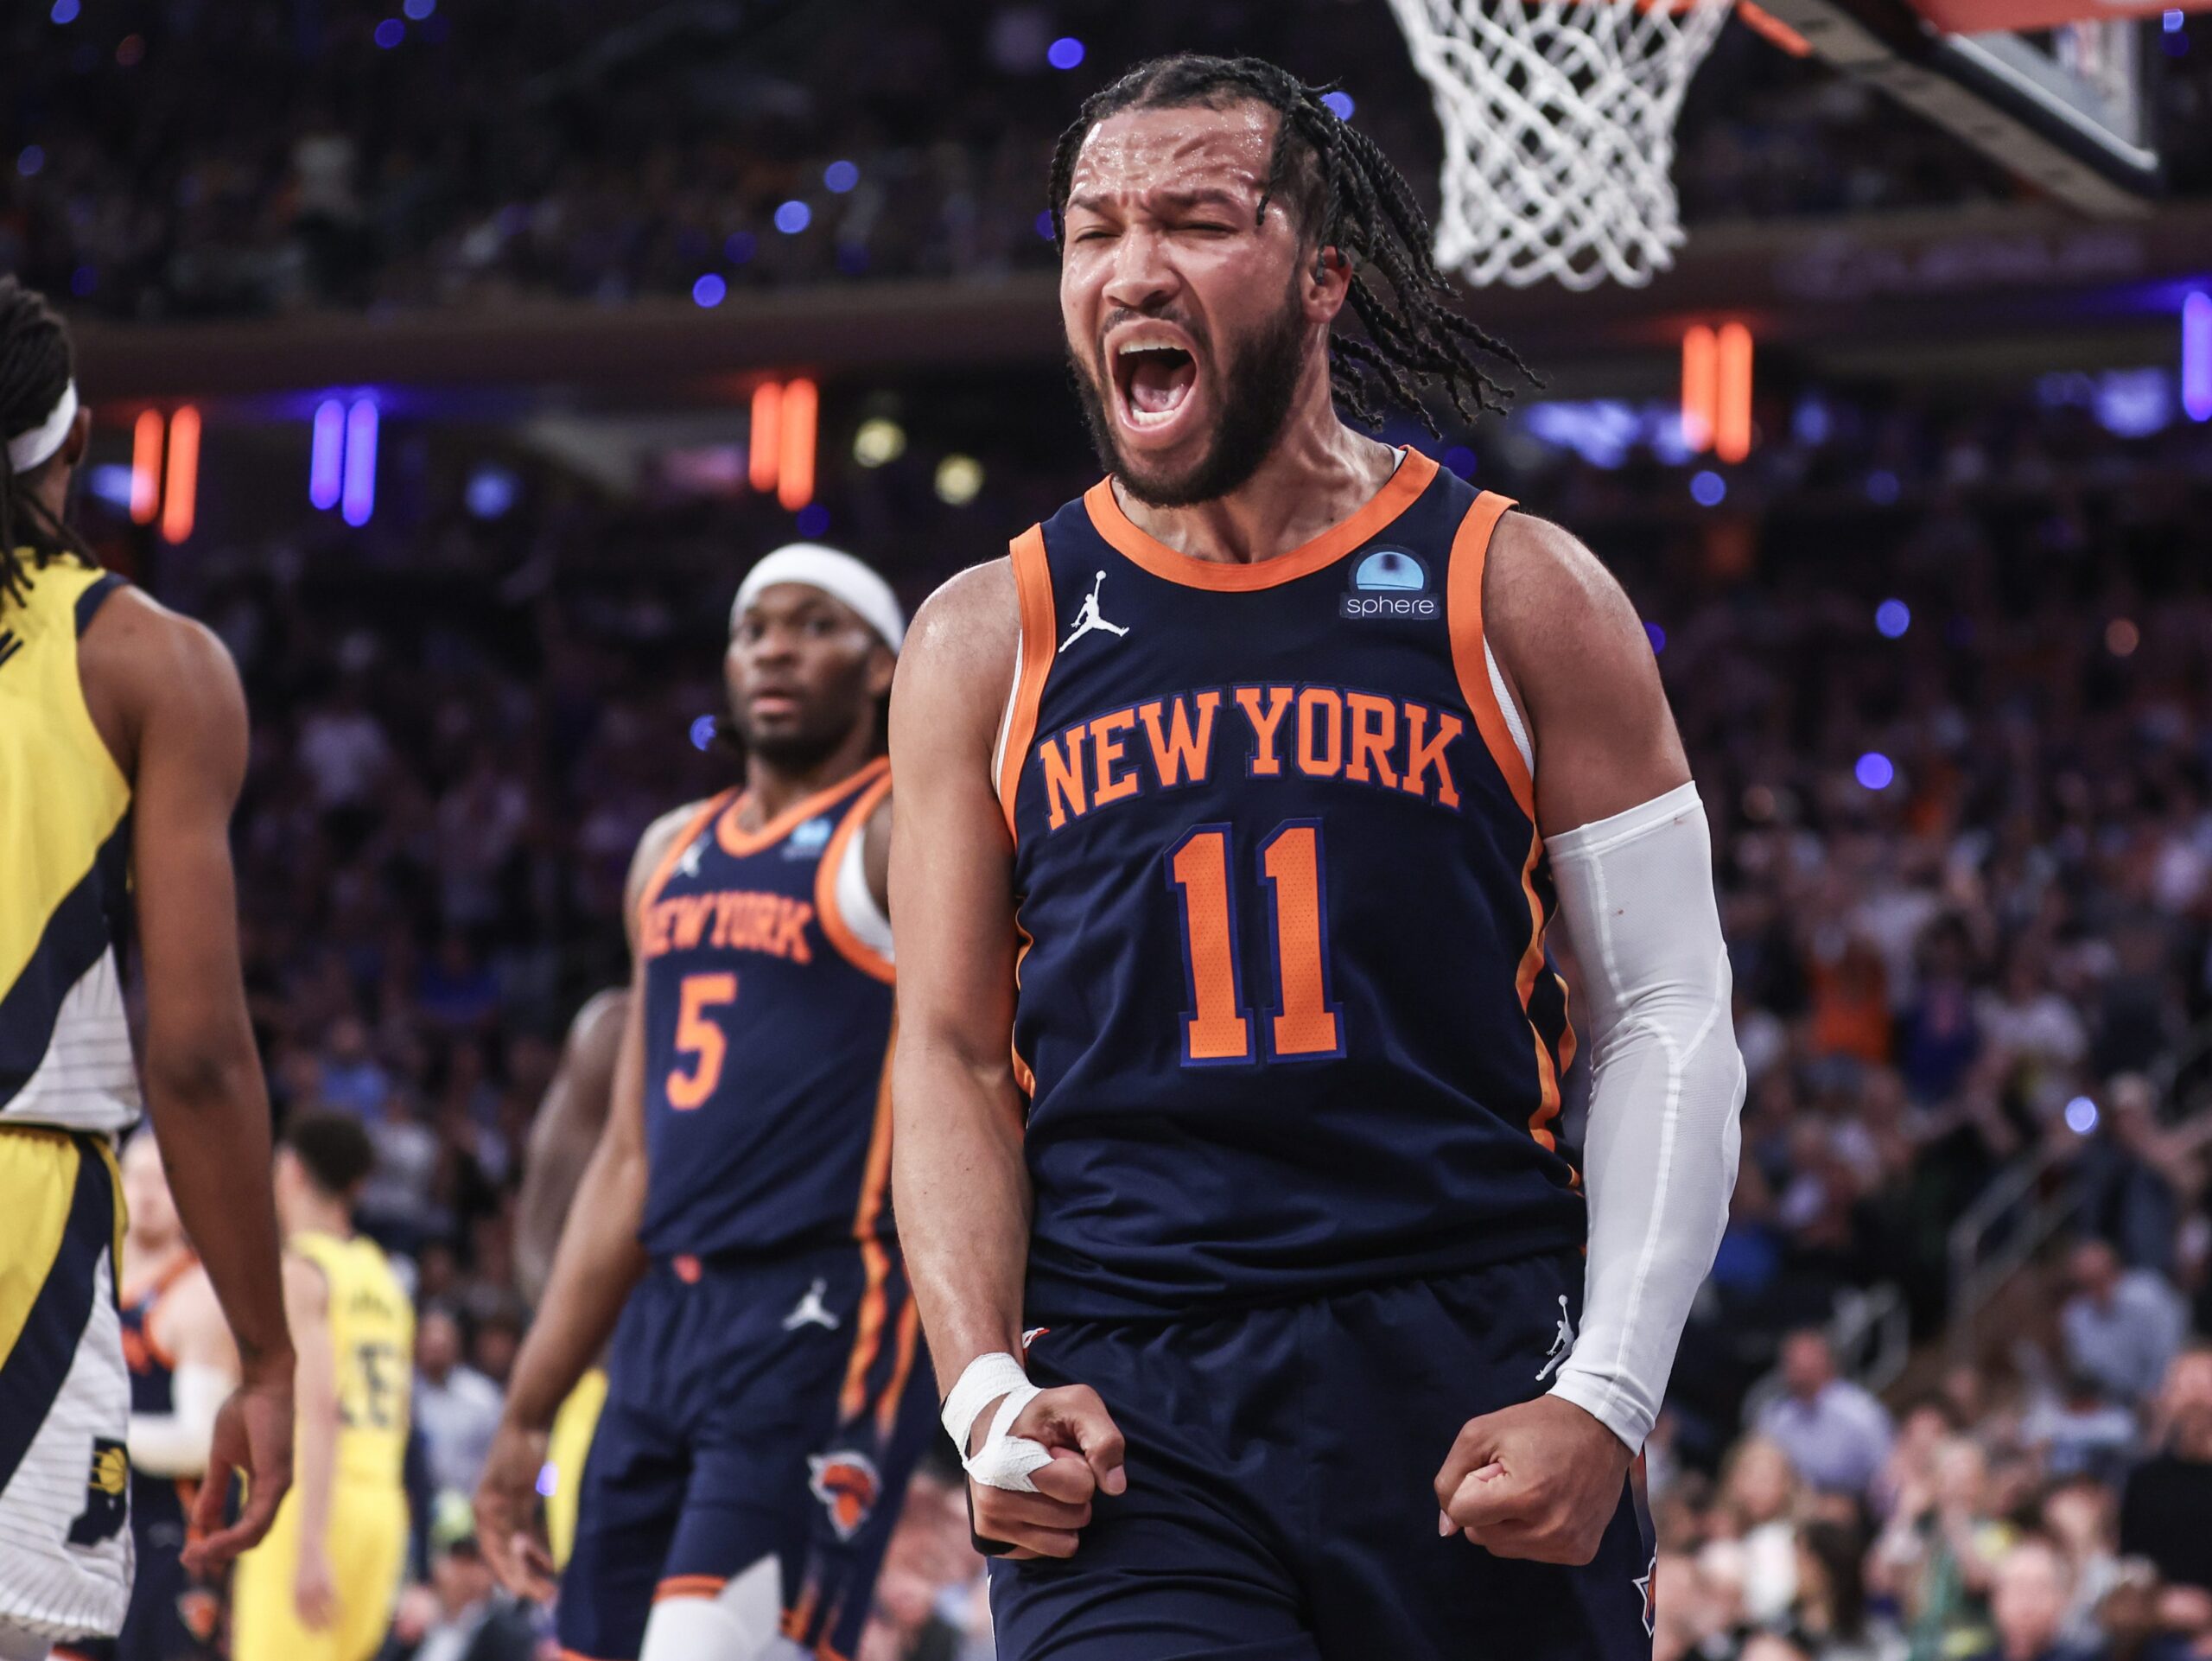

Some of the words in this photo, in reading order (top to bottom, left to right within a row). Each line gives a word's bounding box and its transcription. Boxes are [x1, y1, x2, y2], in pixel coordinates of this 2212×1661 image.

[1346, 595, 1435, 618] sphere
[1039, 690, 1221, 832] NEW
[1233, 685, 1464, 811] YORK
[1166, 819, 1345, 1066] 11
[666, 972, 737, 1111] 5
